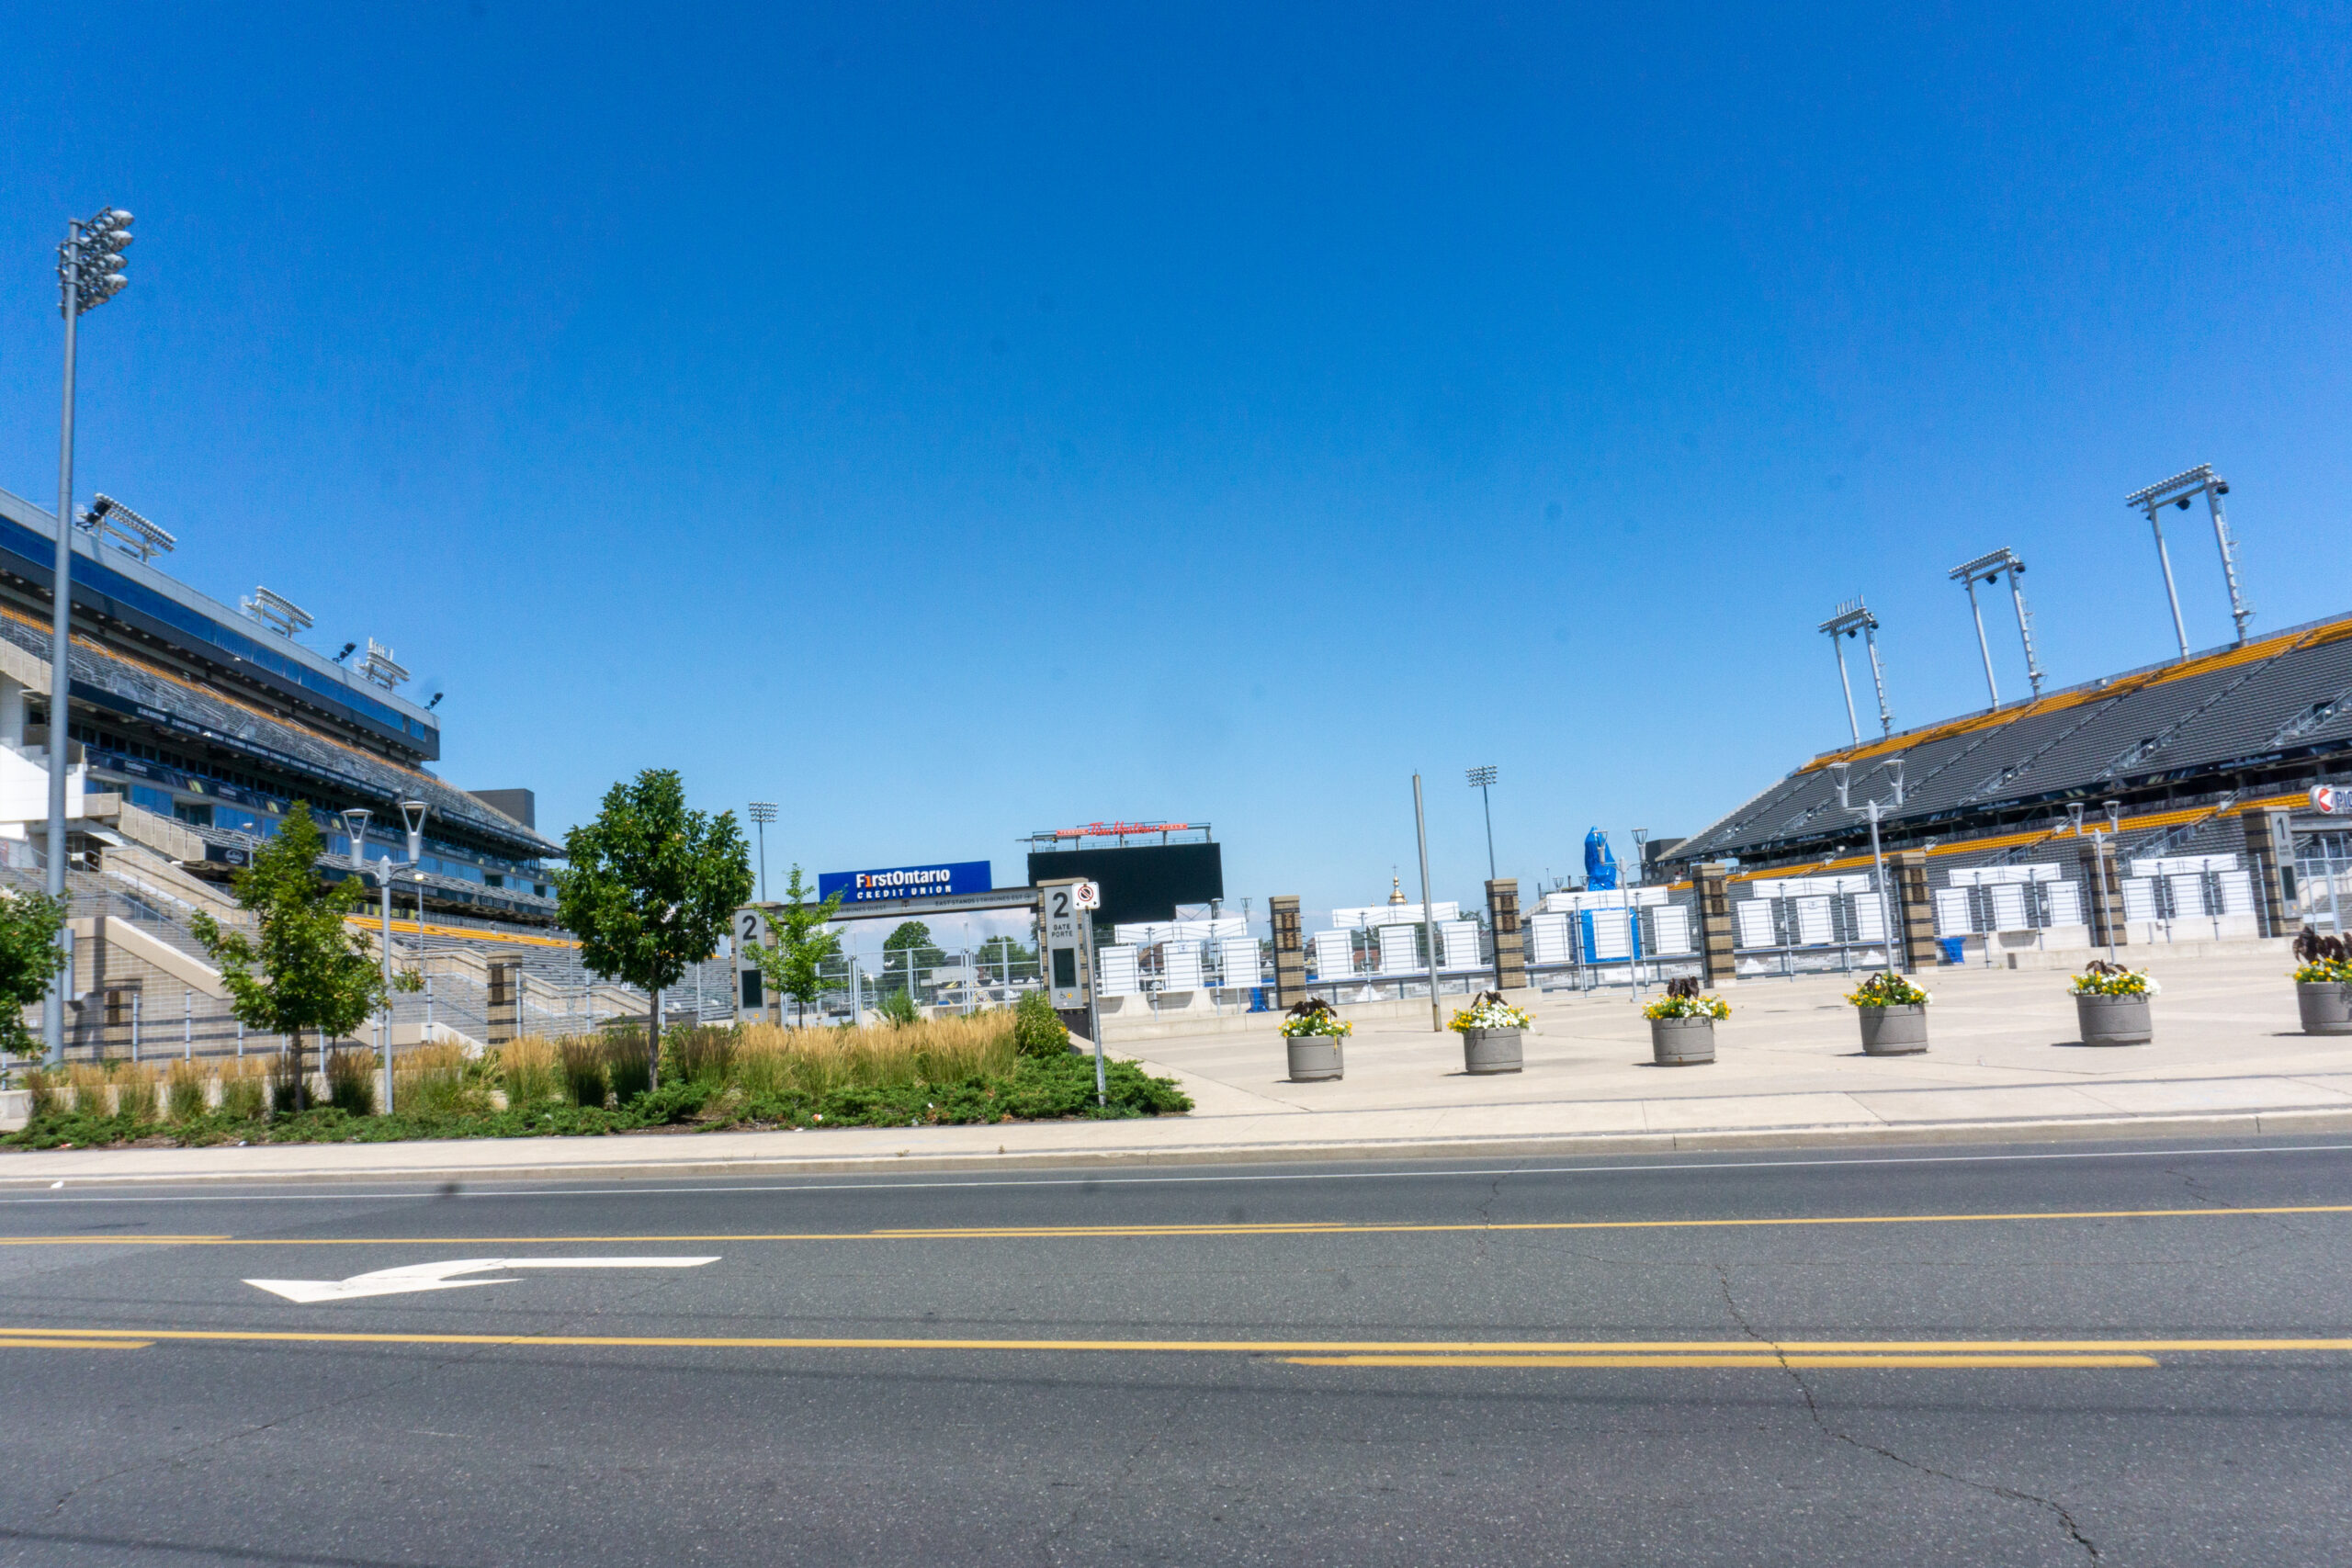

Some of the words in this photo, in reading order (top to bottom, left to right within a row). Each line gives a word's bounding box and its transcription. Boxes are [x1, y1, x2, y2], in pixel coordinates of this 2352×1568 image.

[1089, 821, 1112, 836] Tim
[1113, 819, 1157, 835] Hortons
[856, 888, 904, 900] CREDIT
[910, 885, 952, 897] UNION
[1052, 891, 1069, 919] 2
[742, 914, 758, 941] 2
